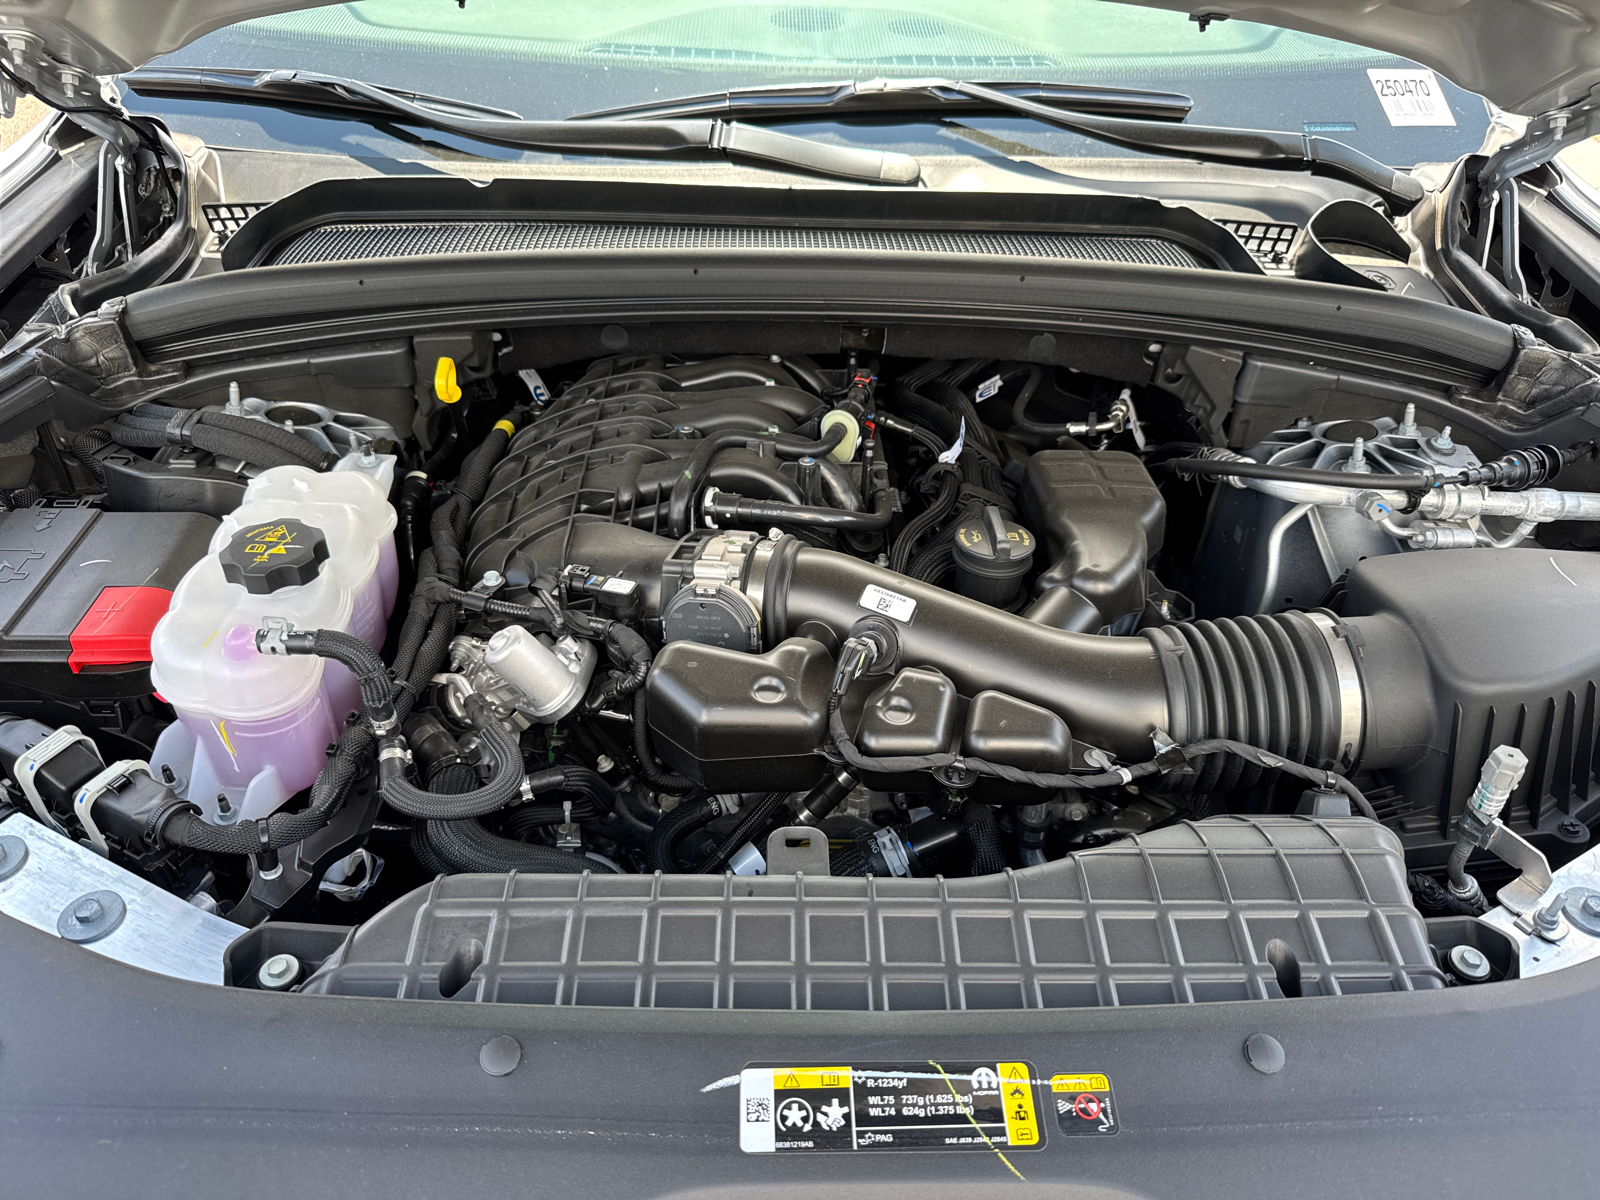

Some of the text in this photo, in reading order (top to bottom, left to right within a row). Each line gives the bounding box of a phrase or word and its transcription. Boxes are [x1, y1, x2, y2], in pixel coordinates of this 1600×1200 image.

[1375, 79, 1431, 97] 250470
[706, 796, 720, 816] ENG
[867, 838, 880, 854] ENG
[867, 1078, 908, 1089] R-1234yf
[868, 1095, 895, 1105] WL75
[901, 1095, 924, 1106] 737g
[925, 1093, 954, 1105] (1.625
[868, 1104, 975, 1117] WL74 624g (1.375 lbs)
[875, 1133, 893, 1142] PAG
